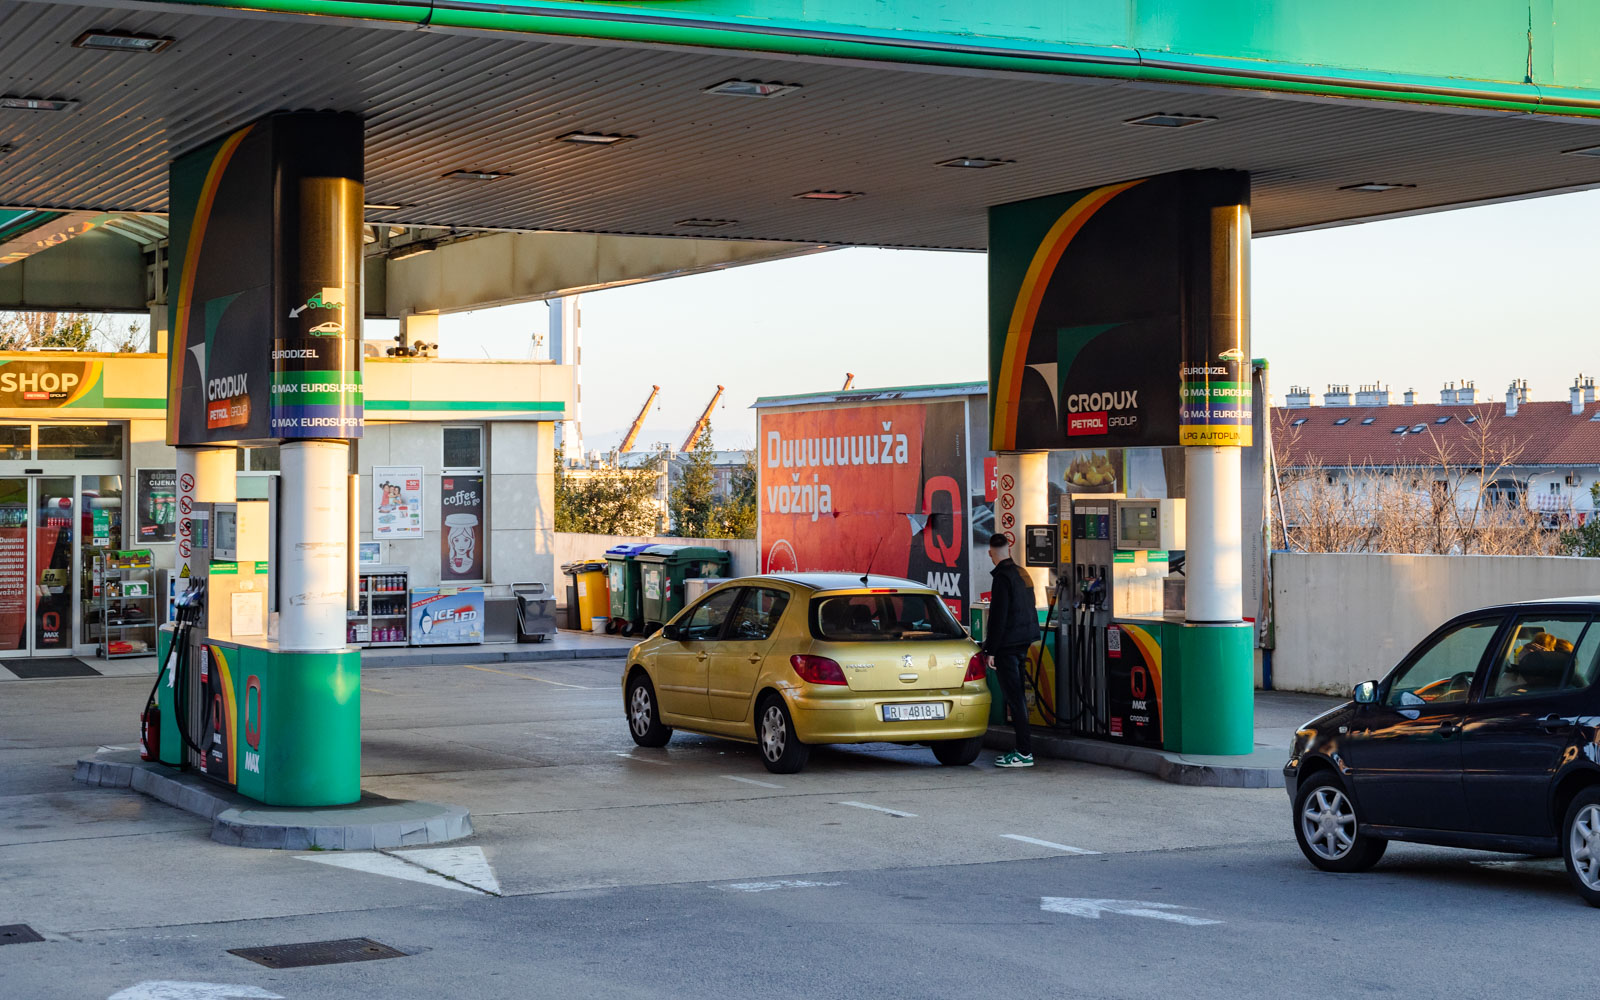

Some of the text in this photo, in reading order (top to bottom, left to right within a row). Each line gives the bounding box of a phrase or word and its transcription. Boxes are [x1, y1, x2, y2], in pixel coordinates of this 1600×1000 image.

[271, 349, 319, 359] EURODIZEL
[1183, 367, 1228, 375] EURODIZEL
[1, 372, 79, 393] SHOP
[208, 372, 248, 401] CRODUX
[271, 384, 277, 394] Q
[278, 383, 298, 393] MAX
[301, 383, 357, 393] EUROSUPER
[1183, 389, 1189, 397] Q
[1191, 388, 1211, 397] MAX
[1067, 390, 1138, 413] CRODUX
[210, 405, 247, 420] PETROL GROUP
[1183, 410, 1189, 418] Q
[1191, 410, 1211, 418] MAX
[271, 418, 277, 428] Q
[278, 418, 298, 428] MAX
[301, 417, 357, 427] EUROSUPER
[1071, 416, 1137, 429] PETROL GROUP
[1183, 432, 1198, 440] LPG
[767, 421, 909, 468] Duuuuuuuža
[443, 490, 476, 506] coffee
[472, 498, 481, 507] go
[767, 473, 832, 522] vožnja
[922, 475, 963, 568] Q
[926, 571, 962, 598] MAX
[43, 611, 60, 632] Q
[434, 608, 477, 623] ICE LED
[1130, 665, 1147, 700] Q
[245, 674, 262, 751] Q
[890, 704, 941, 718] RI 4818-L
[1132, 700, 1147, 710] MAX
[245, 751, 260, 774] MAX
